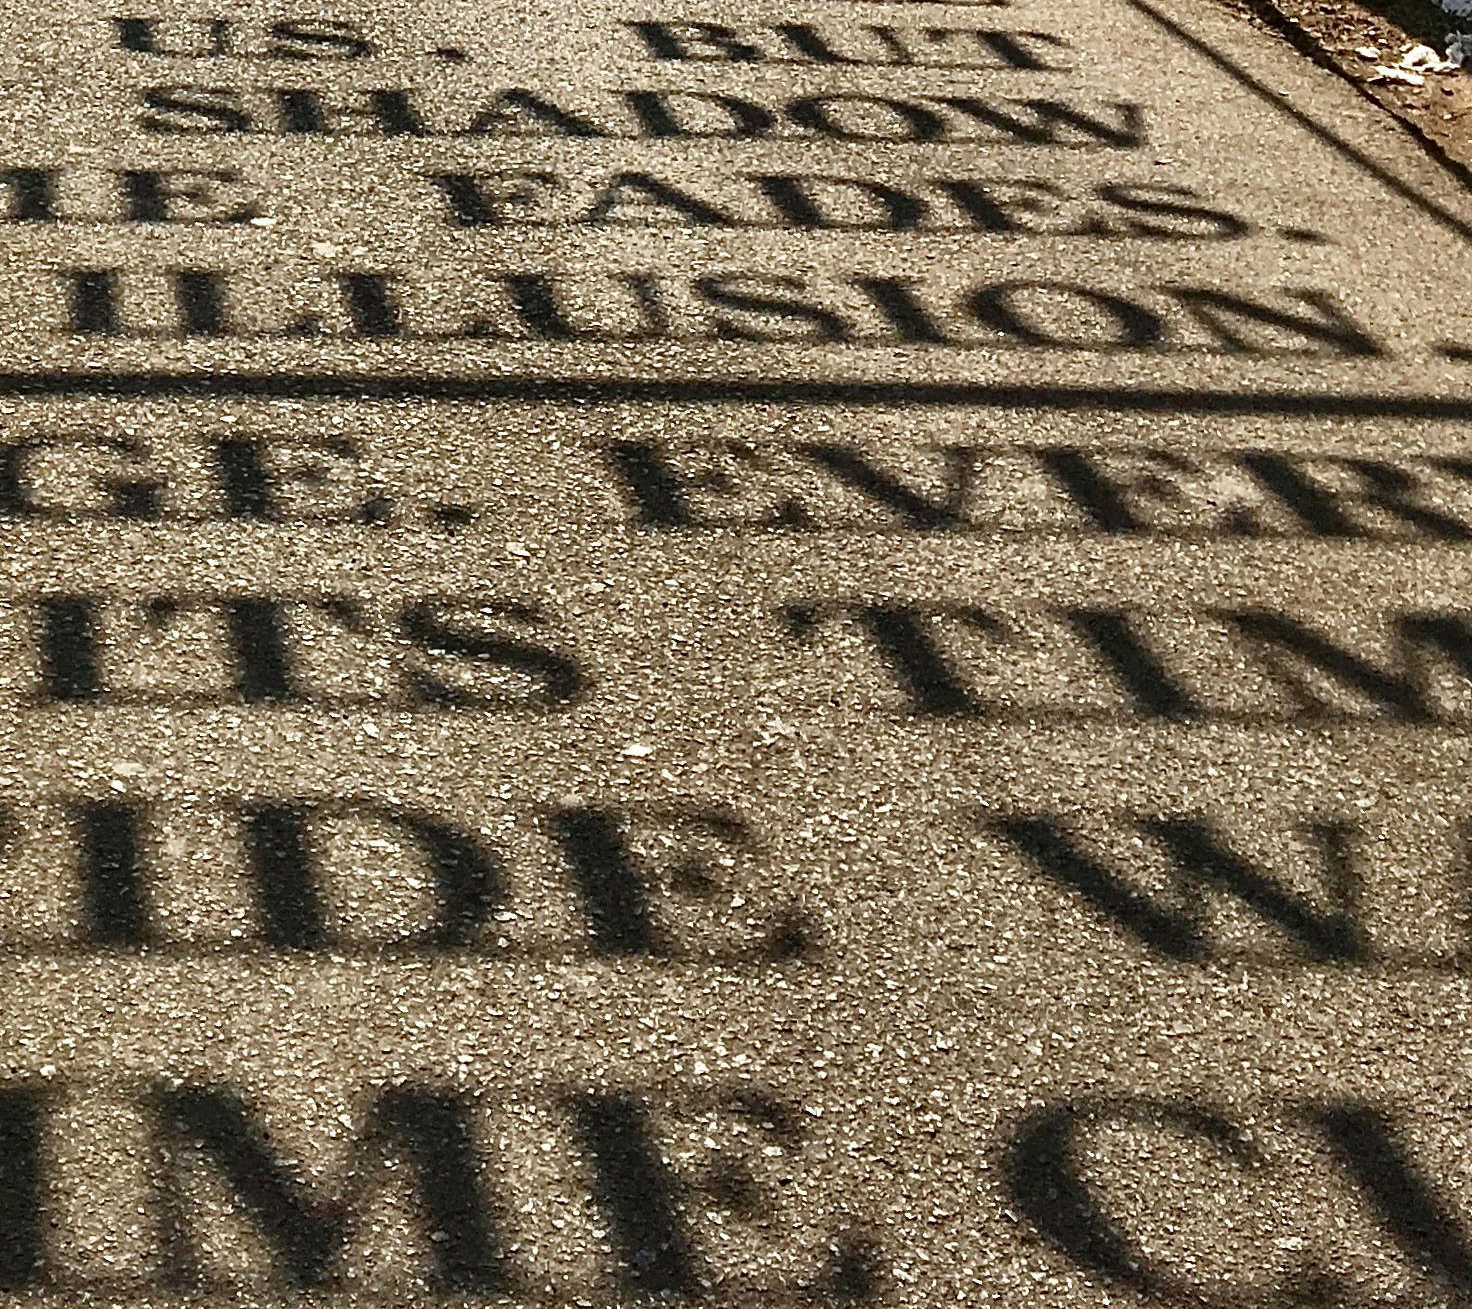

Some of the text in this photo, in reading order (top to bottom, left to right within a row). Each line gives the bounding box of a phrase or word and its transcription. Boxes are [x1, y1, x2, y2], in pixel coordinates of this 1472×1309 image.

[621, 19, 1073, 71] BUT
[142, 85, 1145, 149] SHADOW
[603, 434, 1472, 544] EVER
[25, 589, 594, 712] ITS
[786, 597, 1472, 724] TIM
